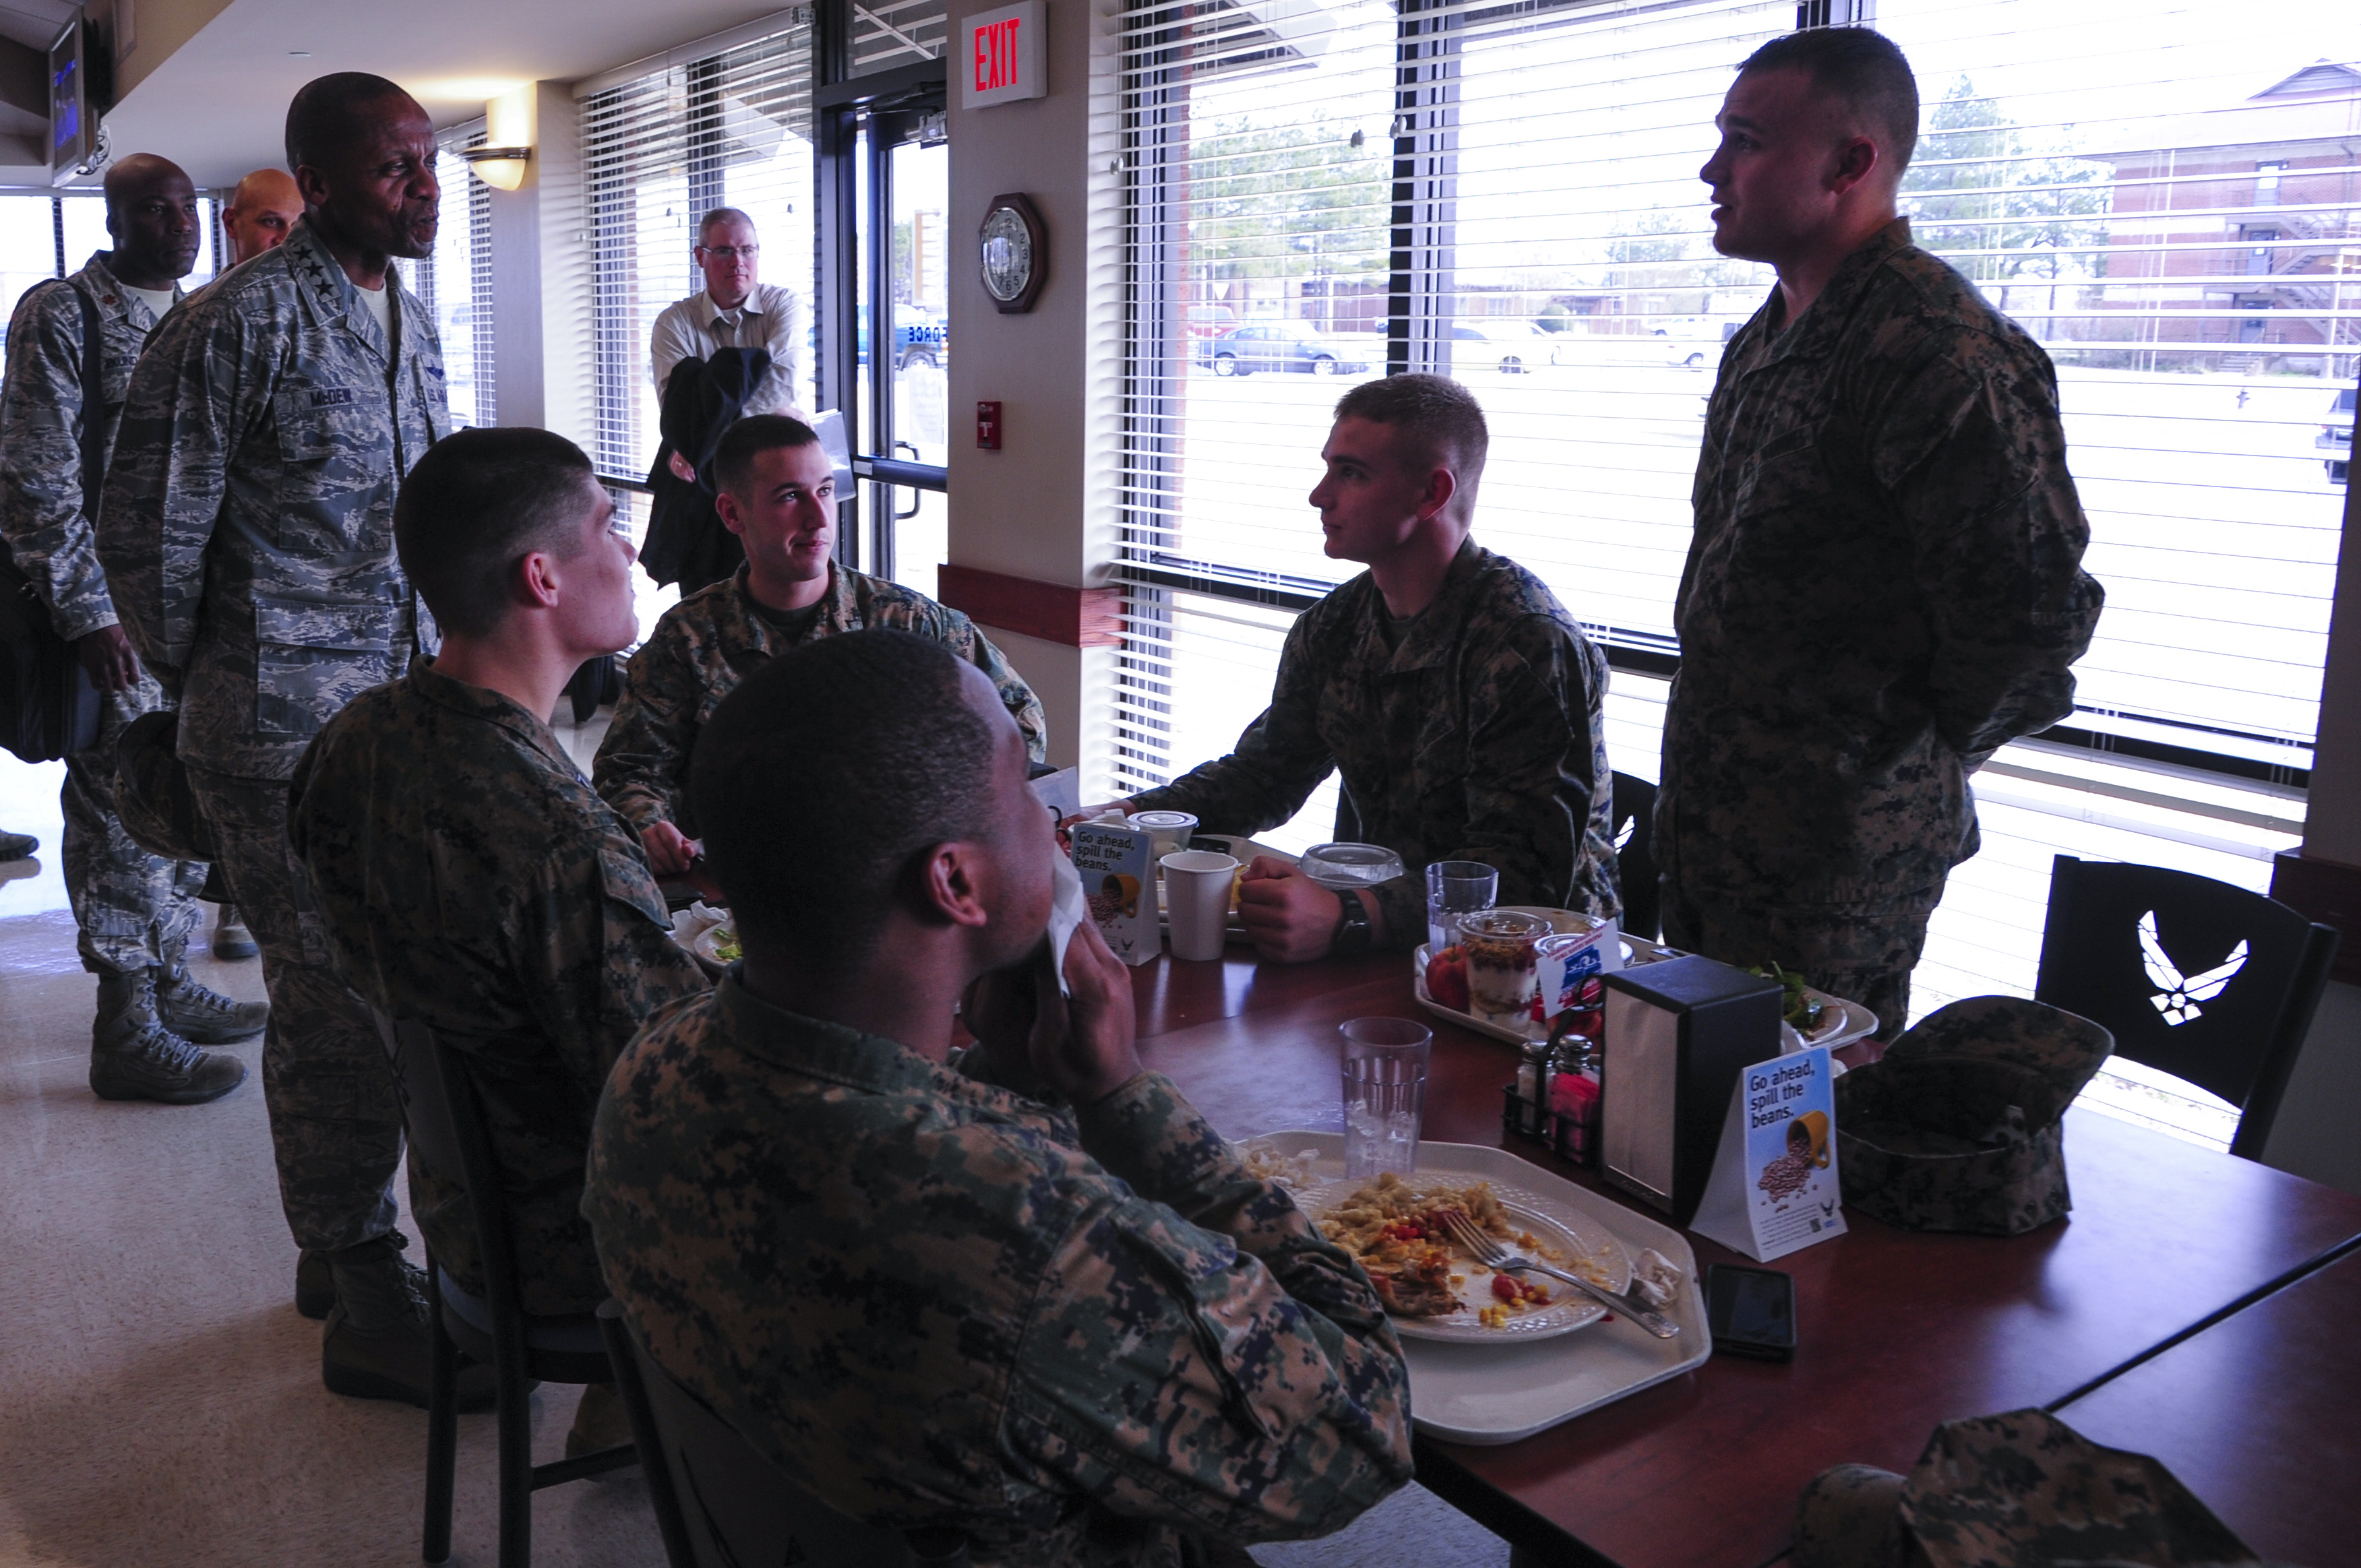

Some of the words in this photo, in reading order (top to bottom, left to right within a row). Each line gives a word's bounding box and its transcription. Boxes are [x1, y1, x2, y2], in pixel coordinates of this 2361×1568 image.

[975, 17, 1020, 92] EXIT
[310, 388, 351, 407] McDEW
[1079, 831, 1093, 843] Go
[1097, 834, 1134, 850] ahead,
[1076, 845, 1101, 858] spill
[1105, 848, 1122, 860] the
[1076, 855, 1111, 871] beans.
[1751, 1075, 1767, 1091] Go
[1772, 1059, 1815, 1085] ahead,
[1750, 1087, 1779, 1112] spill
[1783, 1083, 1803, 1100] the
[1752, 1106, 1794, 1129] beans.
